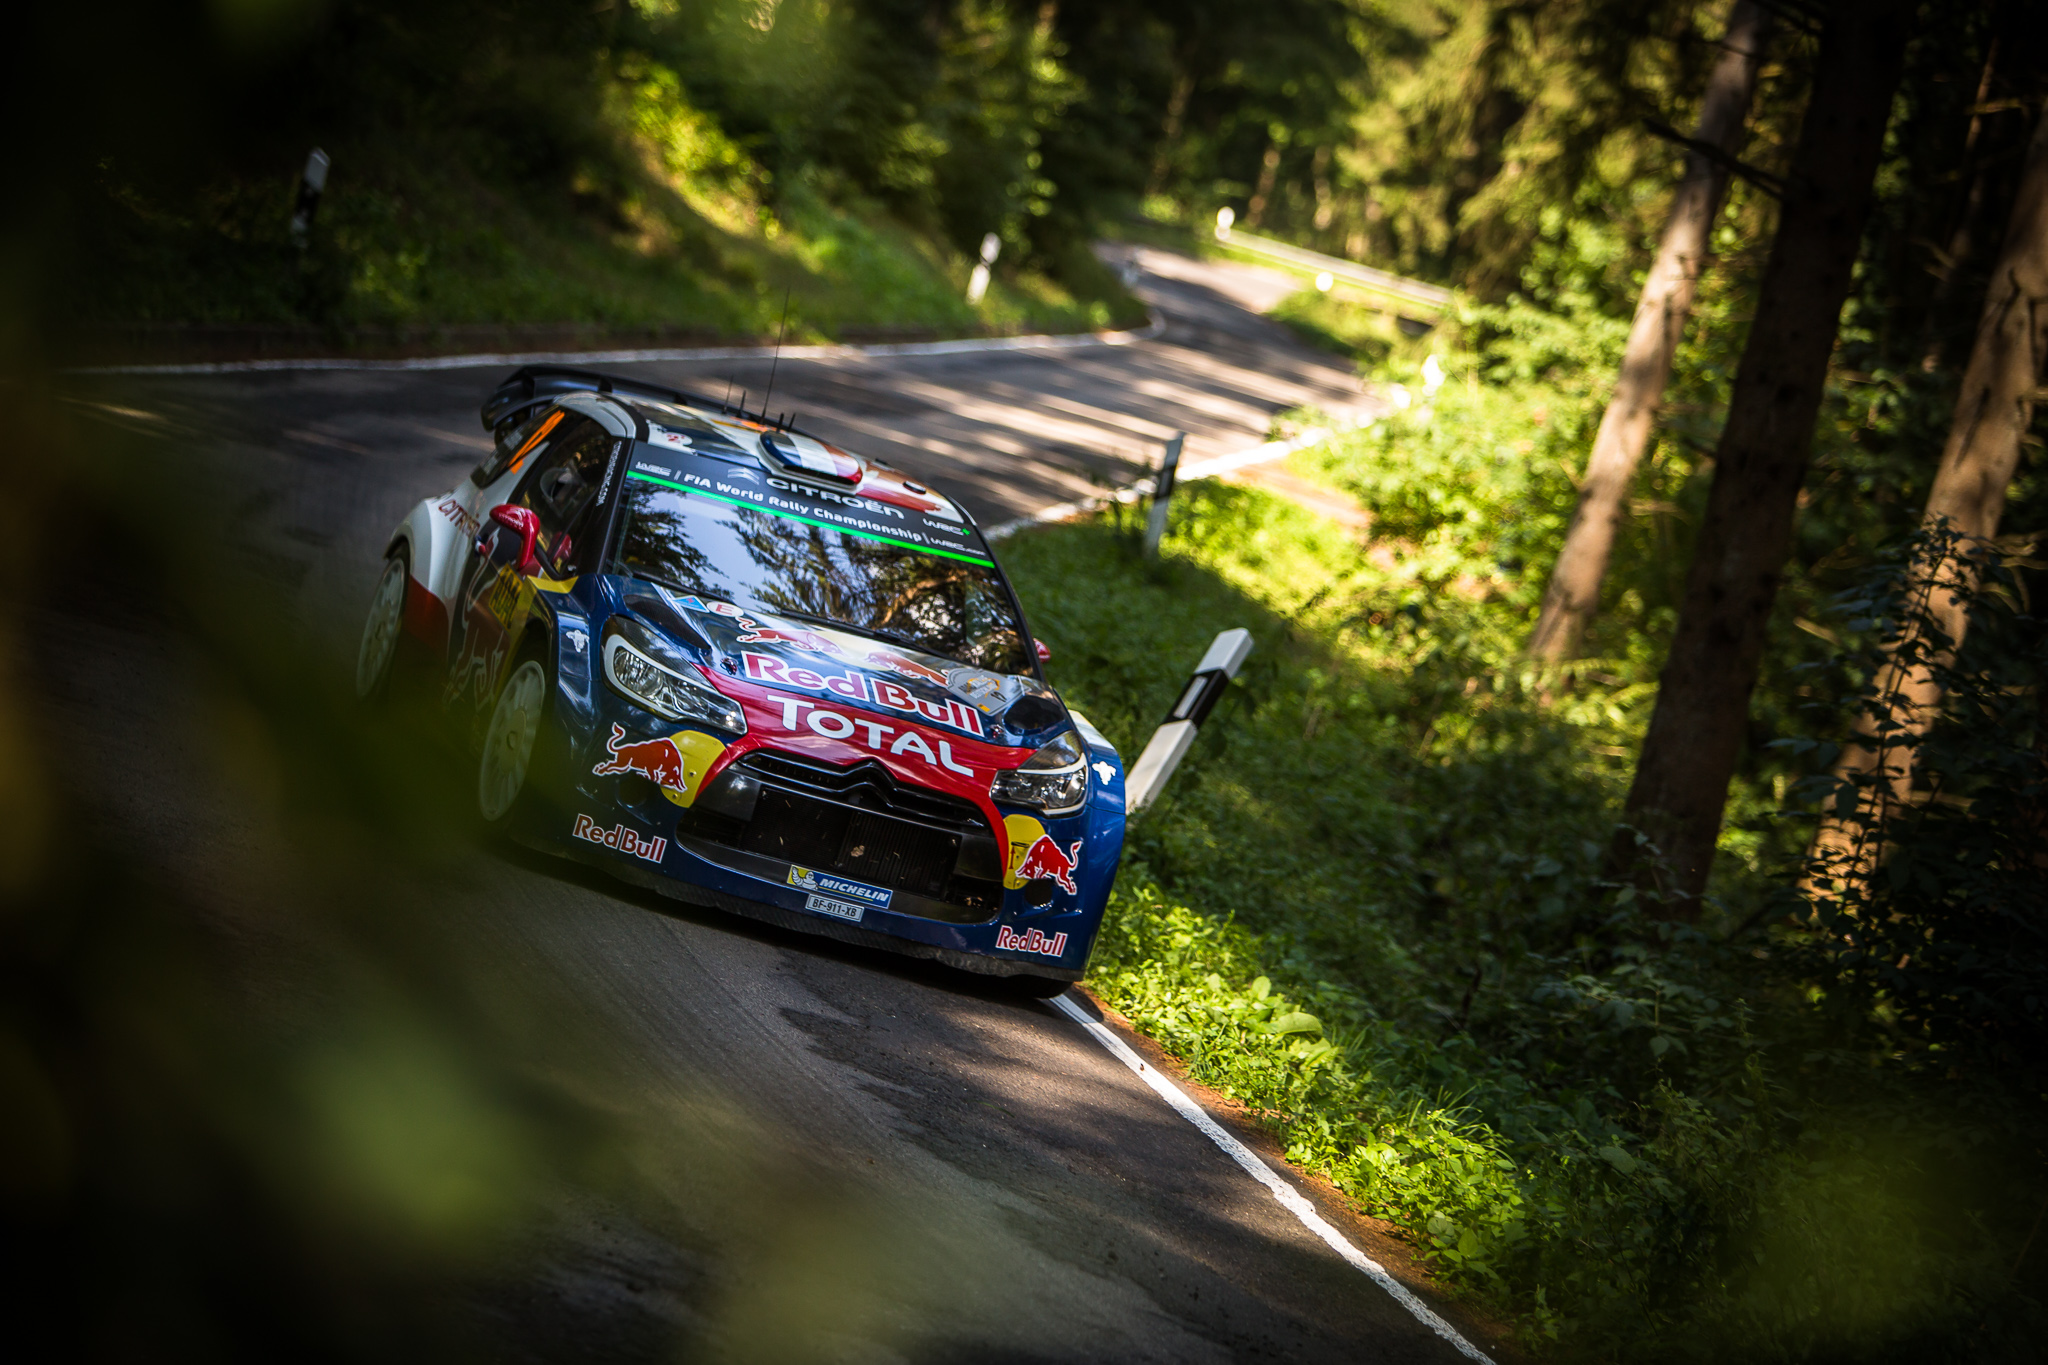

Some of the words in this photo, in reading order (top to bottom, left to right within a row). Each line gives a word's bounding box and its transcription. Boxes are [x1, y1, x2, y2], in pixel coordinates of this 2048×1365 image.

[684, 474, 711, 488] FIA
[717, 478, 763, 502] World
[768, 496, 809, 515] Rally
[814, 507, 923, 543] Championship
[715, 603, 735, 616] E
[741, 651, 869, 702] Red
[870, 677, 985, 737] Bull
[767, 694, 974, 778] TOTAL
[812, 898, 857, 917] BF-911-XB
[819, 878, 889, 902] MICHELIN
